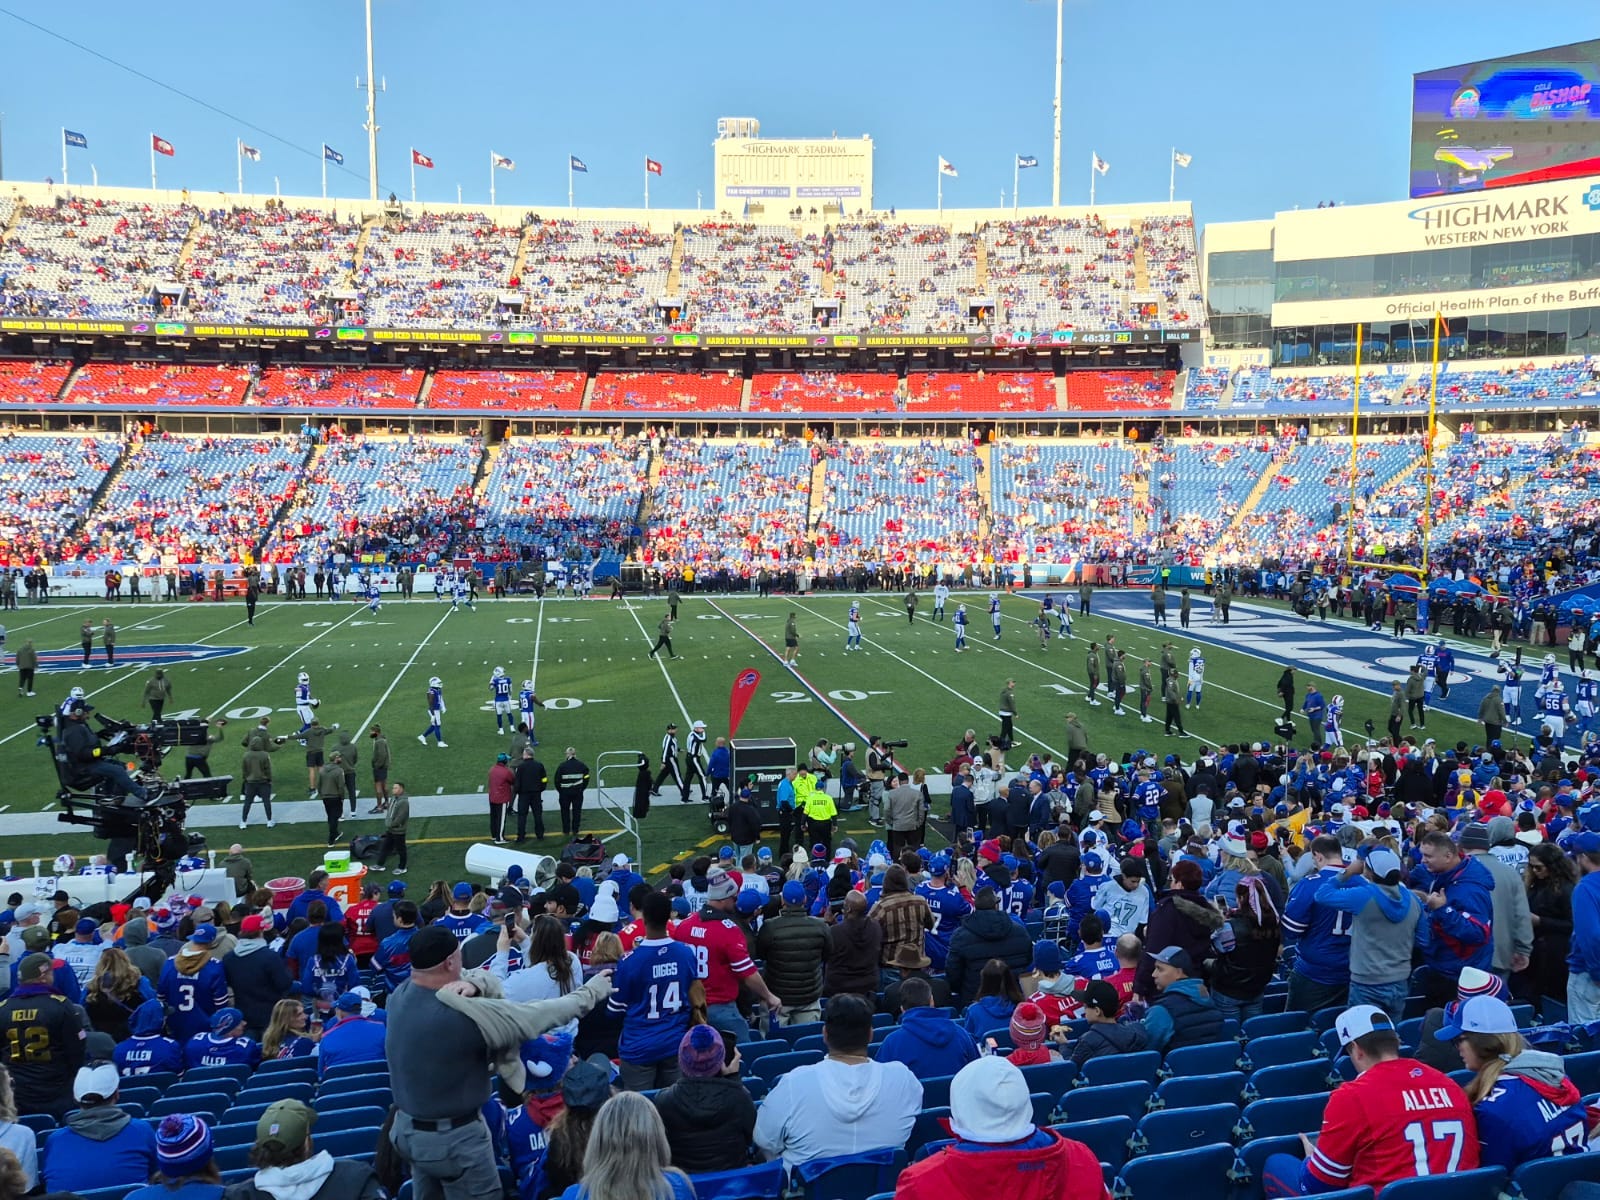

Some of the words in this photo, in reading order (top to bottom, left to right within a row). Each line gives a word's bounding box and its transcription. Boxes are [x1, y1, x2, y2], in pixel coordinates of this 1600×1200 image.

[1530, 84, 1591, 108] BISHOP
[748, 145, 799, 154] HIGHMARK
[804, 145, 846, 154] STADIUM
[1425, 195, 1569, 230] HIGHMARK
[1425, 231, 1489, 246] WESTERN
[1493, 225, 1526, 239] NEW
[1531, 220, 1569, 235] YORK
[1386, 301, 1435, 314] Official
[1440, 297, 1484, 311] Health
[1489, 296, 1519, 308] Plan
[1523, 293, 1538, 305] of
[1541, 291, 1564, 303] the
[61, 322, 77, 331] FOR
[250, 327, 264, 336] FOR
[426, 332, 439, 340] FOR
[593, 335, 606, 343] FOR
[755, 337, 767, 345] FOR
[915, 337, 928, 345] FOR
[1116, 333, 1128, 342] 25
[497, 683, 509, 694] 10
[770, 690, 869, 703] 20
[1546, 698, 1560, 710] 66
[756, 773, 783, 783] Tempo
[1145, 789, 1160, 806] 22
[1113, 901, 1137, 927] 17
[690, 926, 708, 940] KNOX
[652, 961, 678, 979] DIGGS
[1096, 959, 1114, 971] DIGGS
[178, 984, 195, 1012] 3
[647, 981, 683, 1020] 14
[12, 1008, 39, 1022] KELLY
[6, 1026, 52, 1062] 12
[125, 1050, 152, 1062] ALLEN
[201, 1055, 227, 1067] ALLEN
[1401, 1087, 1454, 1111] ALLEN
[1403, 1120, 1464, 1177] 17
